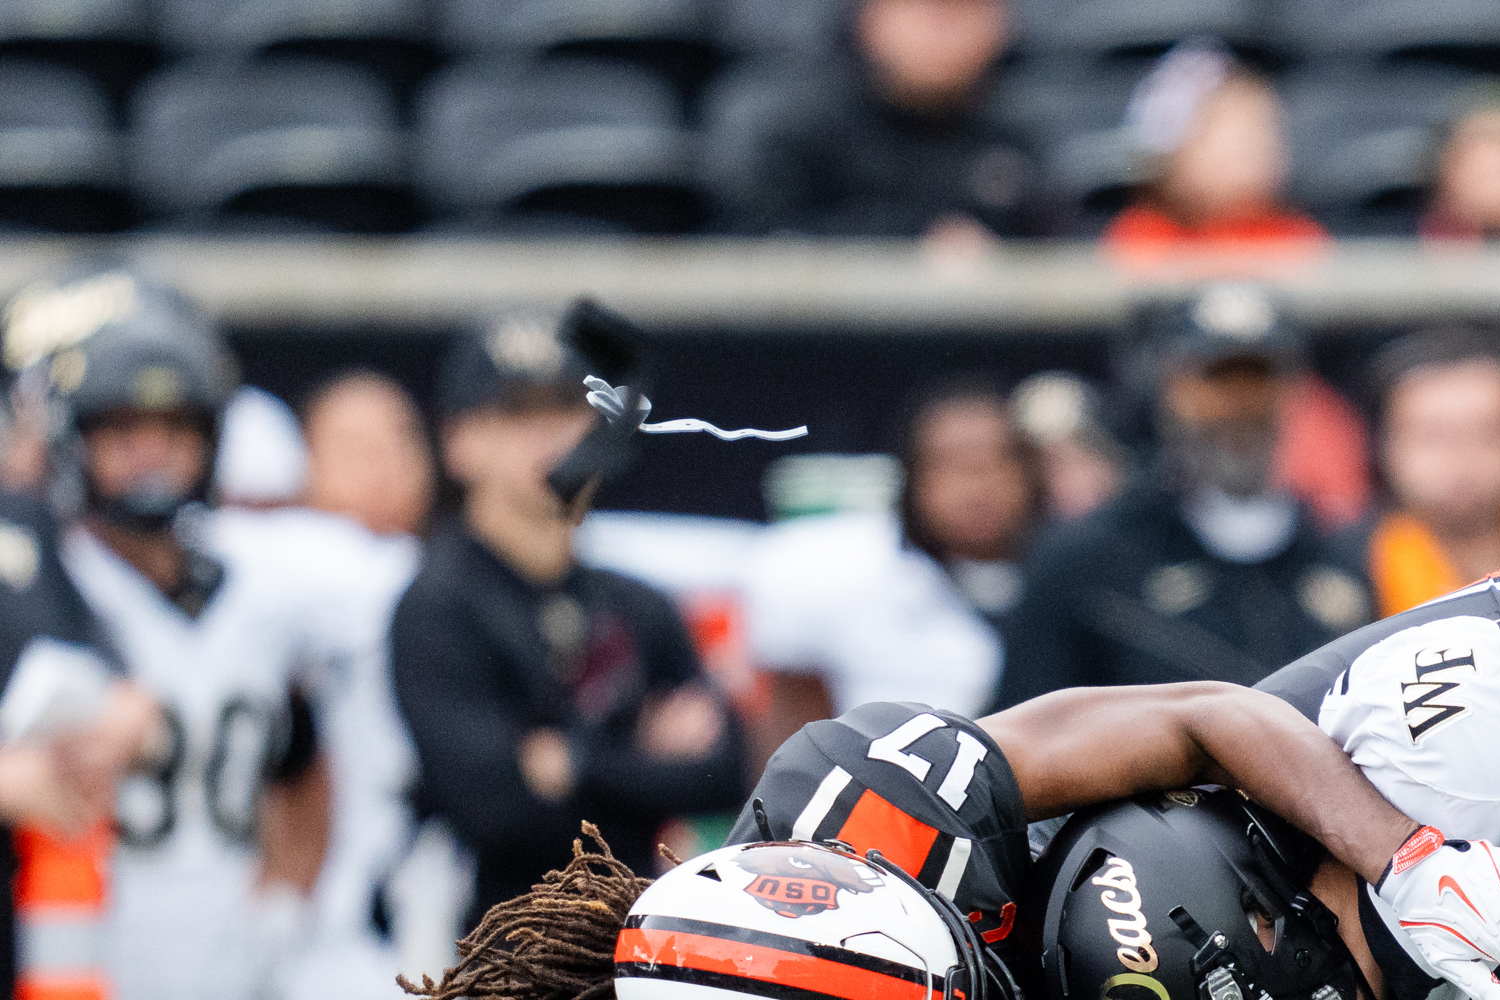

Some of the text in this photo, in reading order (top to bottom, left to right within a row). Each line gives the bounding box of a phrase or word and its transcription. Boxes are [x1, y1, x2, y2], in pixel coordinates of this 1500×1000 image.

[1401, 647, 1476, 743] WF
[867, 713, 988, 812] 17
[757, 877, 830, 901] OSU
